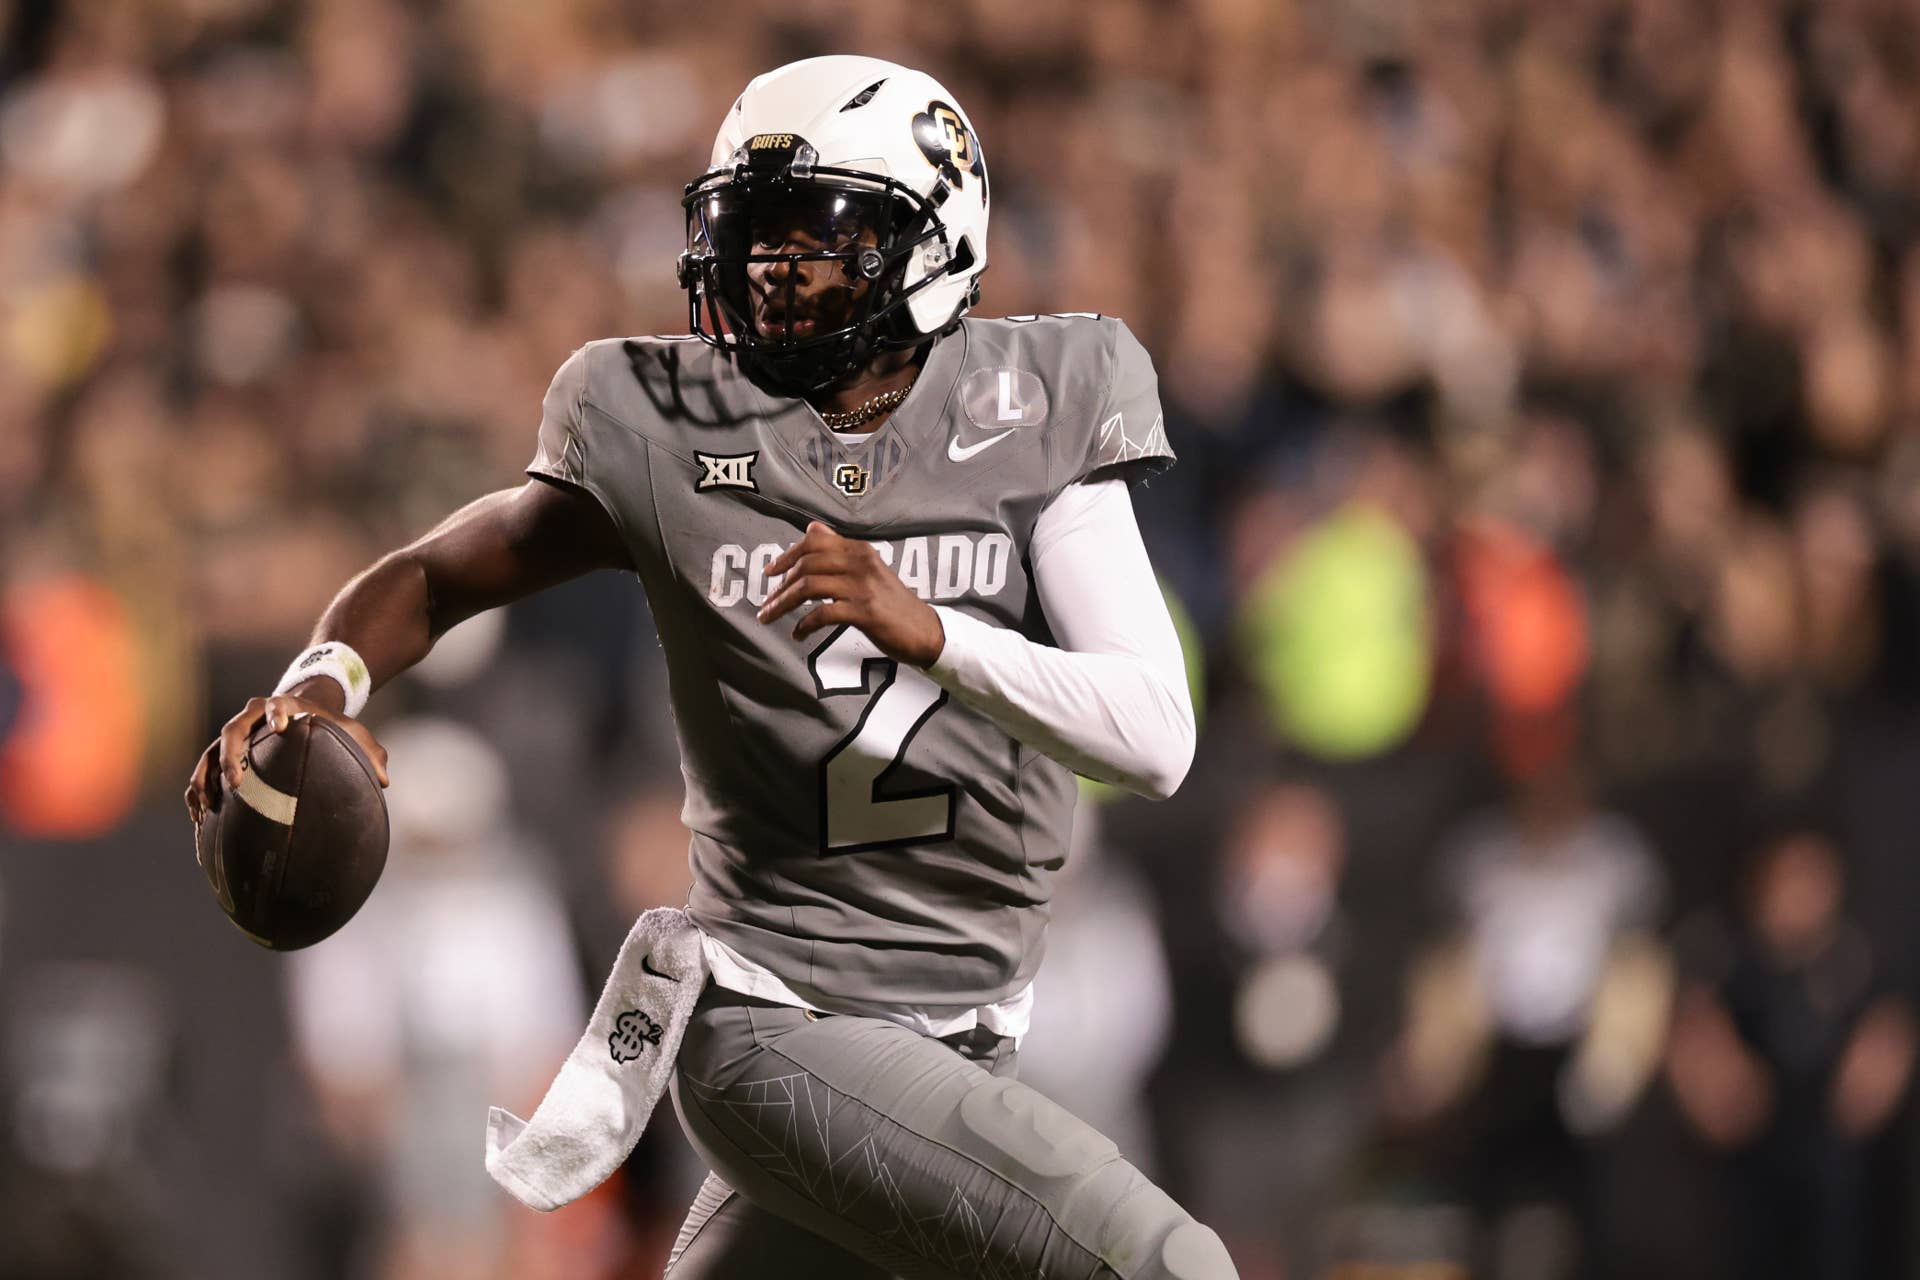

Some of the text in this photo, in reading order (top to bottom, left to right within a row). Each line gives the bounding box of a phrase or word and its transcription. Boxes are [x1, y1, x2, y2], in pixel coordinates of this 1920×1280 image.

[751, 134, 794, 150] BUFFS
[997, 371, 1023, 421] L
[699, 454, 756, 488] XII
[834, 463, 871, 497] CU
[708, 533, 1011, 607] COADO
[808, 624, 956, 859] 2
